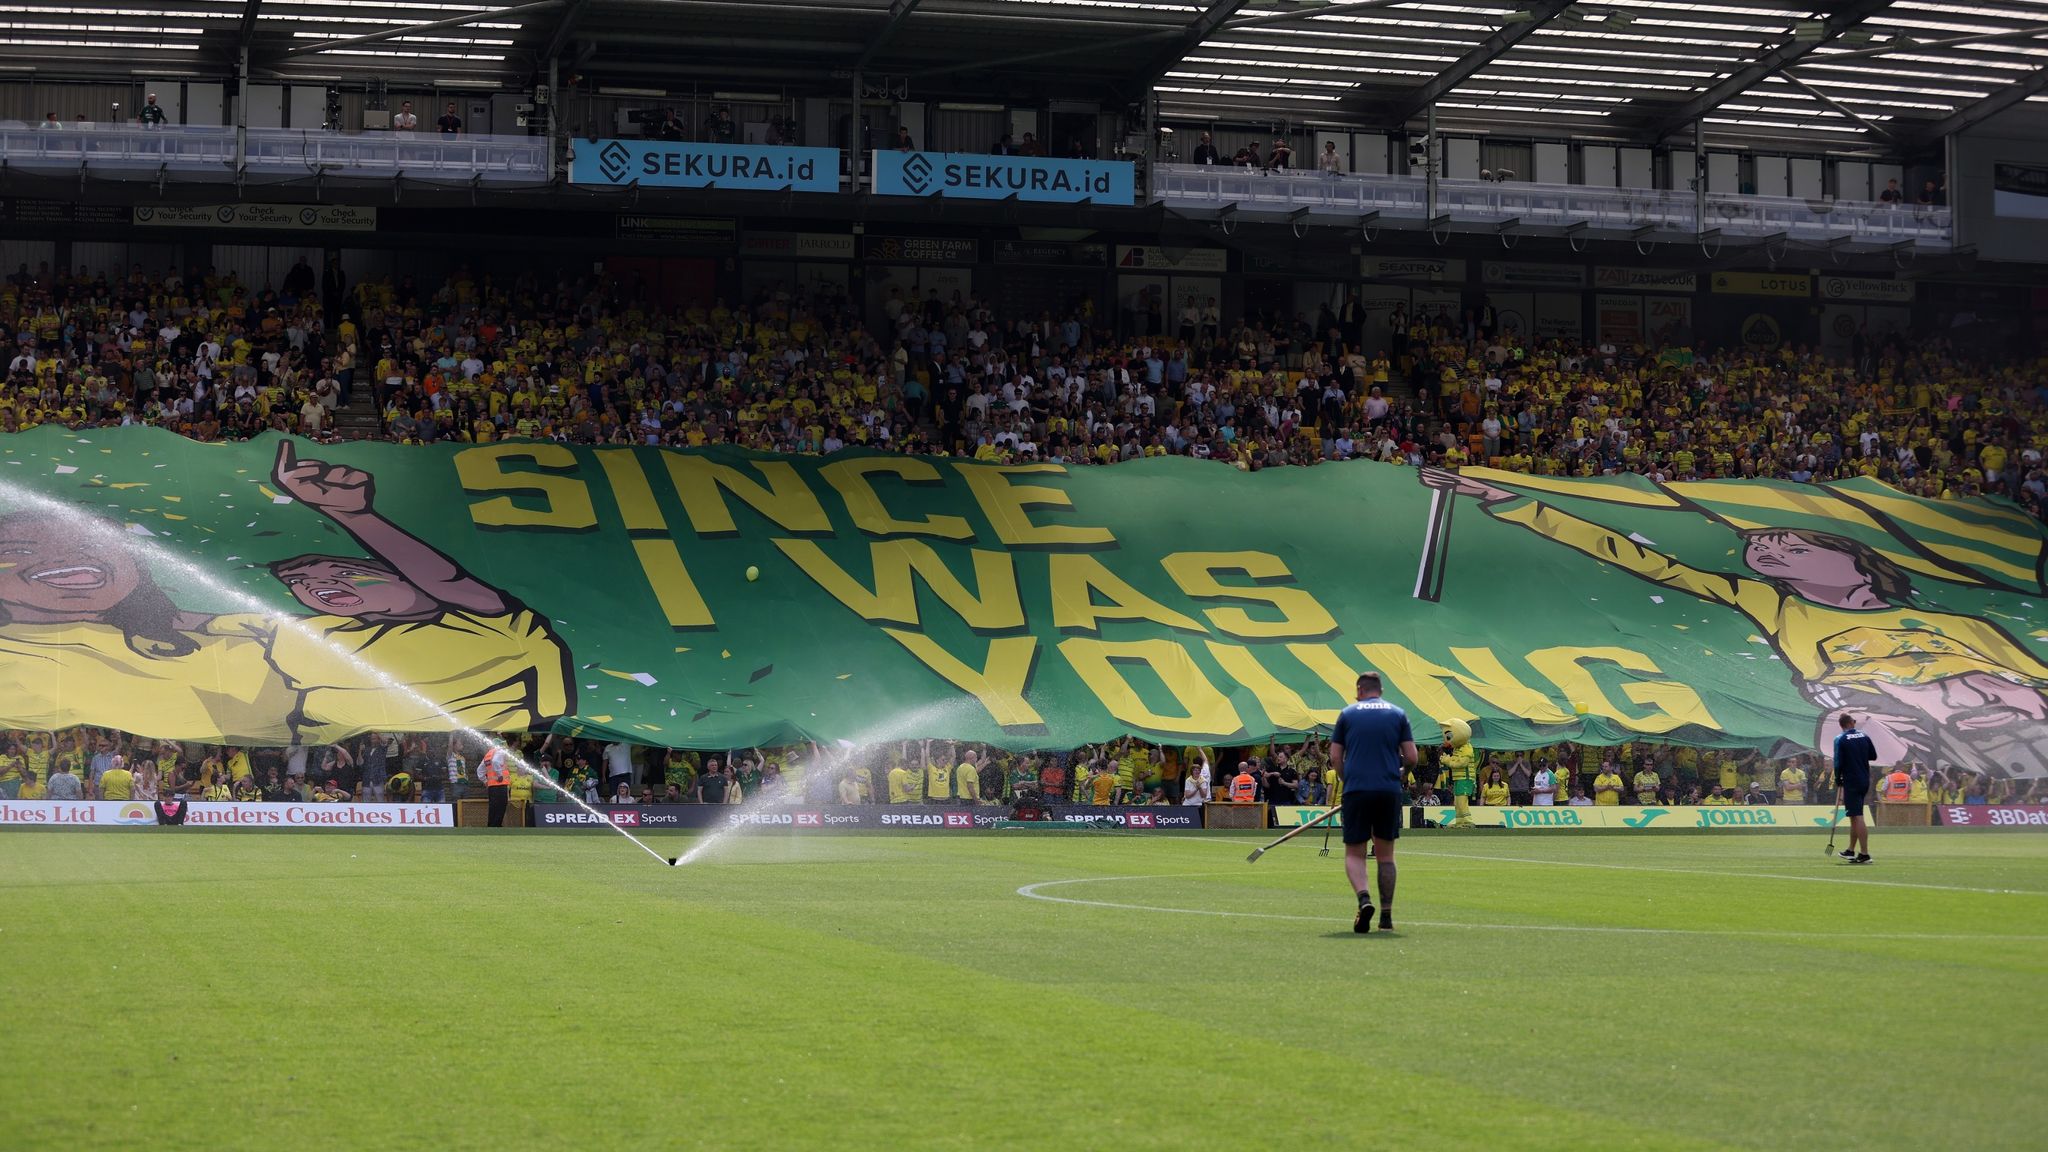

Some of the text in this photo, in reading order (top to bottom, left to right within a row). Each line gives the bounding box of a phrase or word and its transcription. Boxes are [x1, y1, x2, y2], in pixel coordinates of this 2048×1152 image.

[643, 152, 814, 180] SEKURA.id
[944, 164, 1110, 193] SEKURA.id
[157, 211, 212, 222] Your Security
[249, 206, 275, 215] Check
[331, 208, 356, 217] Check
[239, 213, 293, 224] Your Security
[321, 215, 375, 226] Your Security
[621, 217, 648, 228] LINK
[800, 239, 850, 249] JARROLD
[904, 239, 971, 250] GREEN FARM
[904, 249, 943, 259] COFFEE
[1379, 262, 1446, 273] SEATRAX
[1600, 269, 1629, 282] ZATU
[1761, 279, 1807, 291] LOTUS
[1845, 280, 1906, 292] YellowBrick
[1652, 302, 1687, 318] ZATU
[453, 442, 1118, 547] SINCE
[632, 537, 1342, 638] I WAS
[881, 627, 1723, 735] YOUNG
[0, 805, 96, 822] hes Ltd
[286, 806, 393, 825] Coaches
[399, 806, 442, 825] Ltd
[545, 813, 677, 825] SPREAD EX Sports
[729, 813, 859, 826] SPREAD EX Sports
[1499, 809, 1582, 828] Joma
[1696, 808, 1776, 827] Joma
[1988, 804, 2048, 825] 3BDat
[881, 814, 1009, 826] SPREAD EX Sports
[1130, 815, 1151, 825] EX
[1156, 815, 1190, 826] Sports
